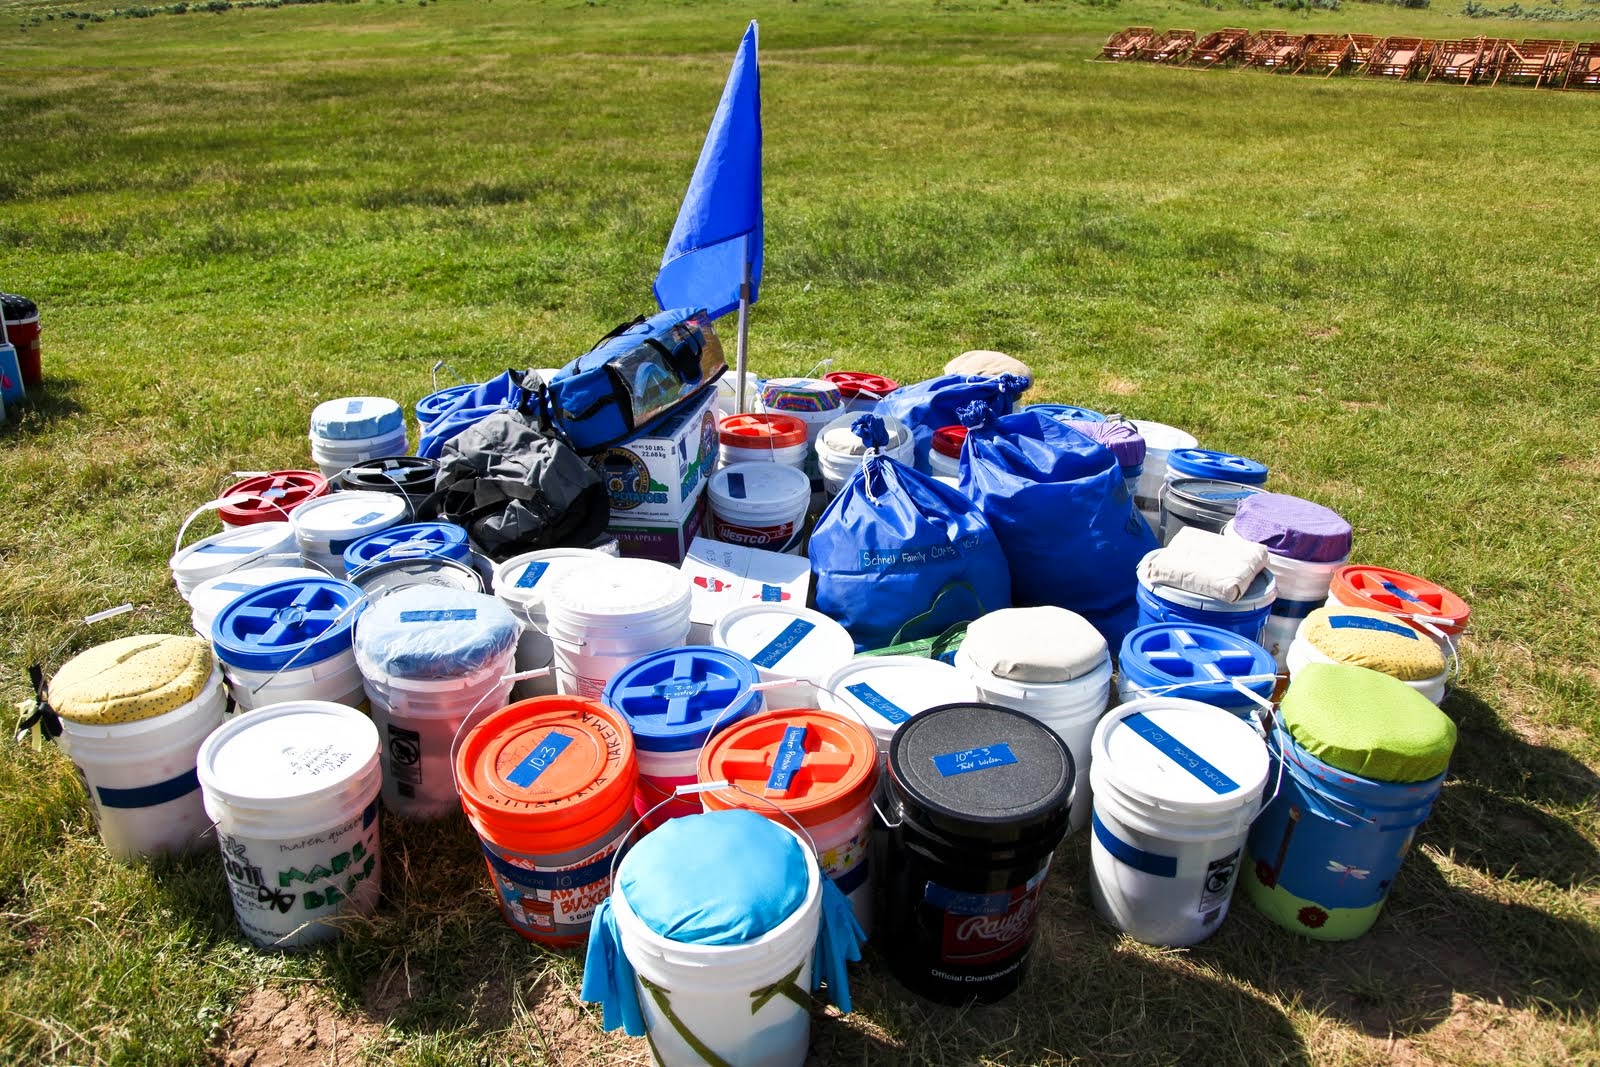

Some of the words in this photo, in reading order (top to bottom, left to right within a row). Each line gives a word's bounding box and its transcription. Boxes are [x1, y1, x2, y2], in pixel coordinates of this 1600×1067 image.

[611, 492, 668, 504] POTATOES
[634, 534, 662, 542] APPLES
[720, 526, 767, 544] WESTCO
[863, 551, 896, 566] Schnell
[901, 551, 926, 563] Family
[1141, 727, 1167, 744] 10-1
[527, 746, 556, 771] 10-3
[1201, 766, 1230, 789] Abby
[931, 969, 963, 982] Official
